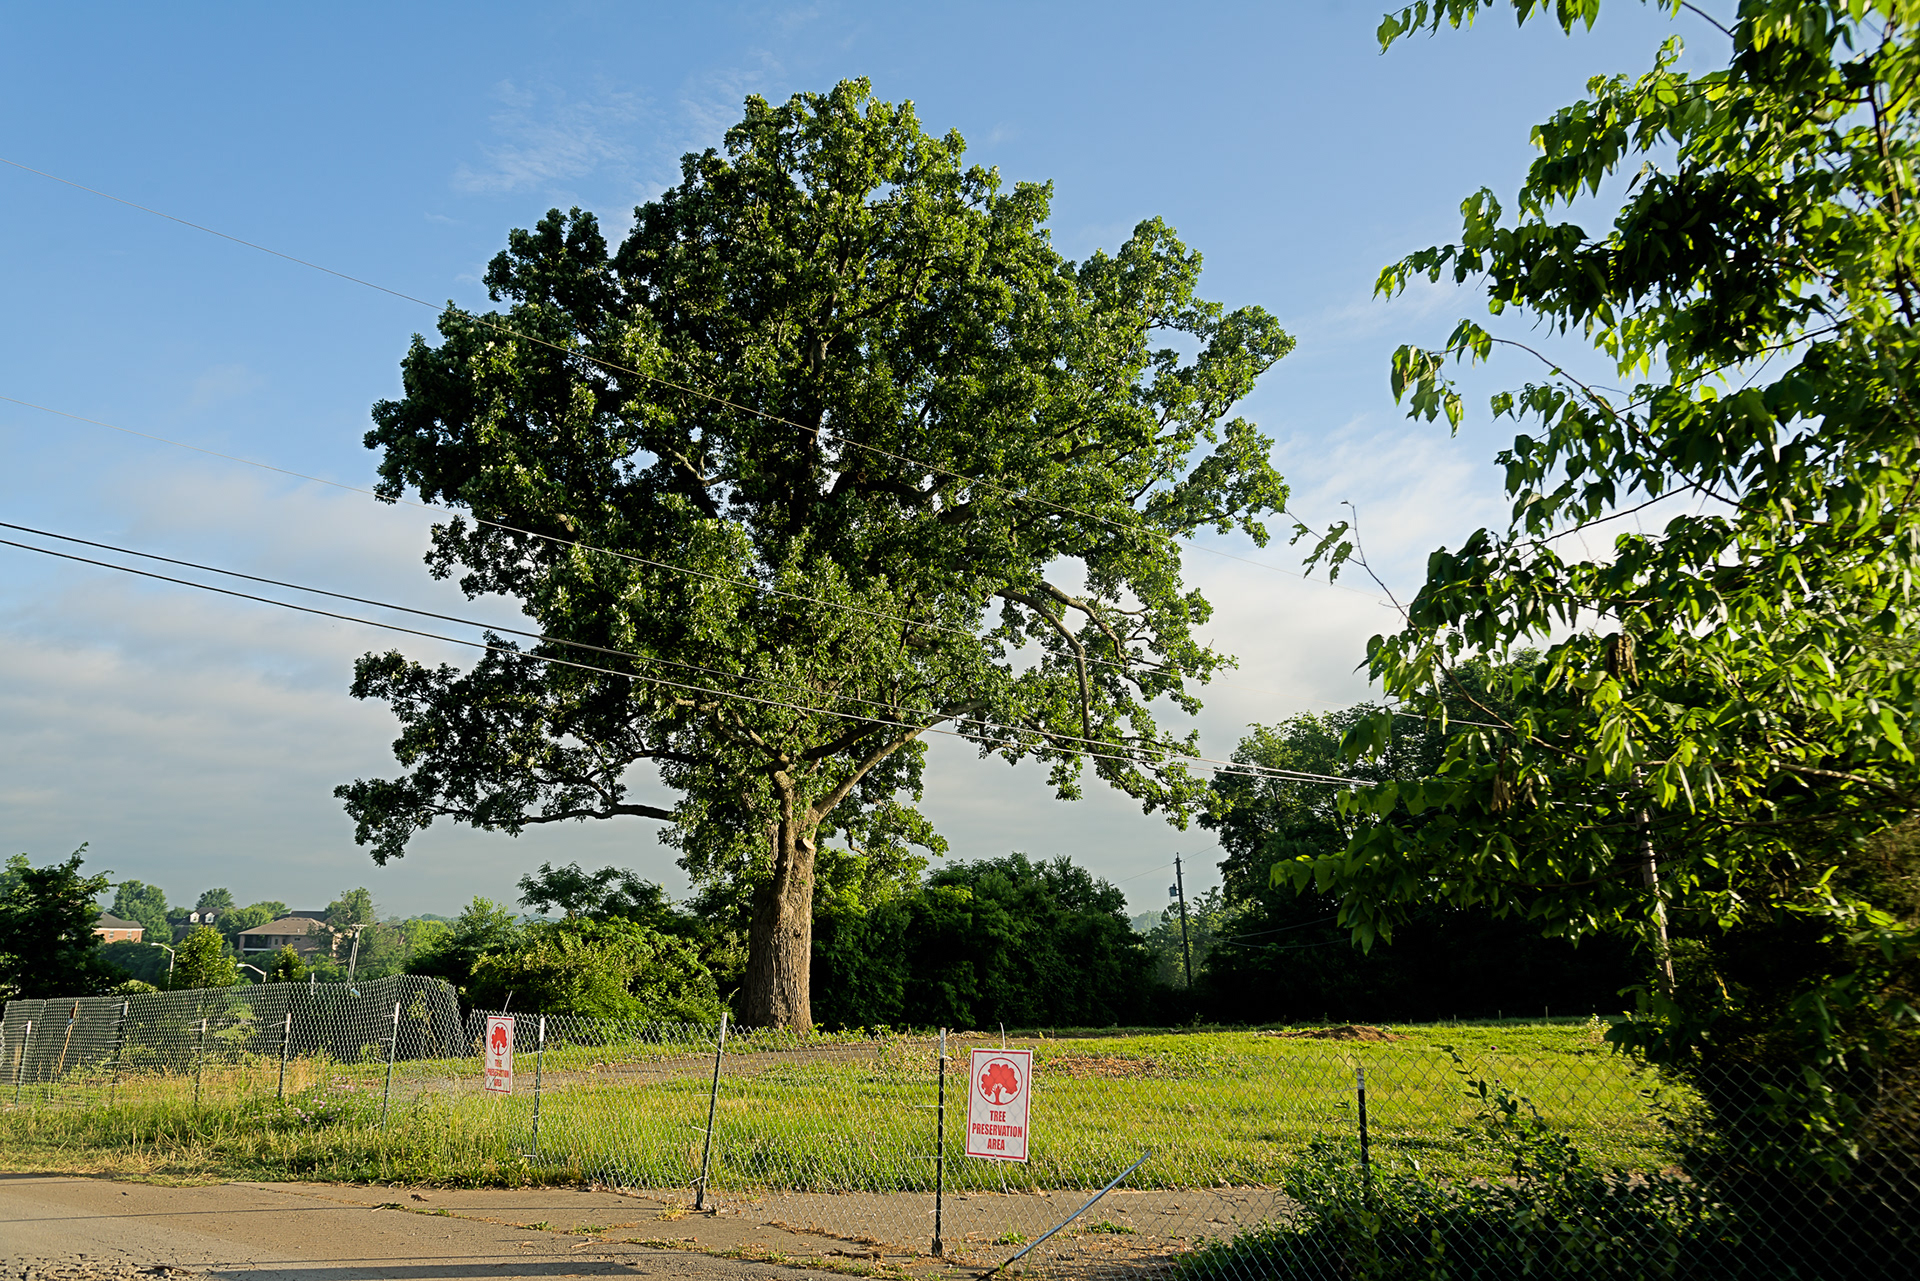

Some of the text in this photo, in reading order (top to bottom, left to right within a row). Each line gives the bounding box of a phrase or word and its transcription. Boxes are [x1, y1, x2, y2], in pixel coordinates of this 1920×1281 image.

[990, 1110, 1006, 1122] TREE
[972, 1123, 1023, 1138] PRESERVATION
[987, 1138, 1005, 1150] AREA
